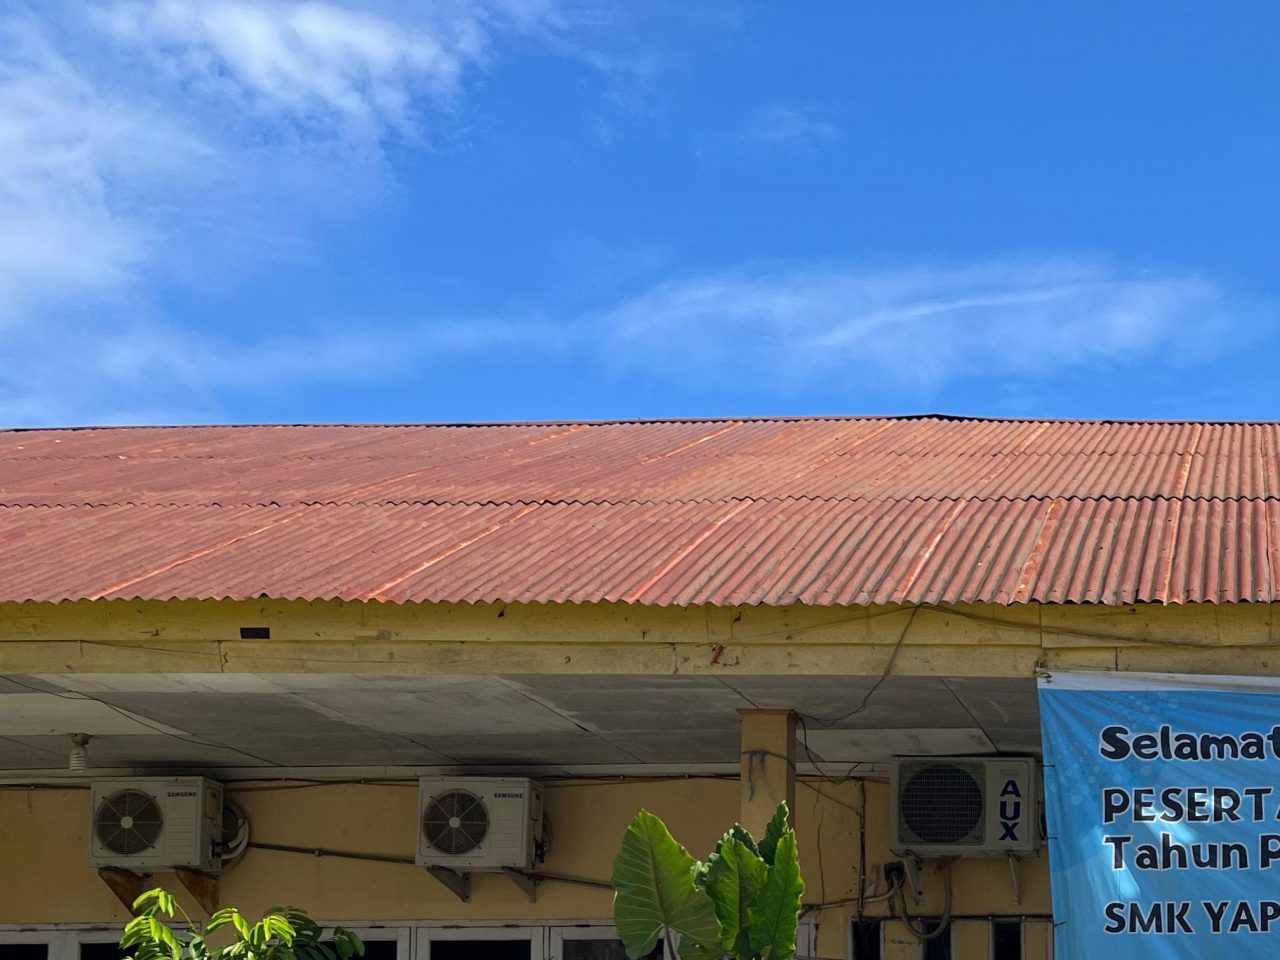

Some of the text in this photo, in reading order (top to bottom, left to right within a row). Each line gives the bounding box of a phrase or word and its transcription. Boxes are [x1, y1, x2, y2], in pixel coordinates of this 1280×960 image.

[999, 779, 1022, 841] AUX
[1103, 832, 1249, 871] Tahun
[1103, 901, 1197, 935] SMK
